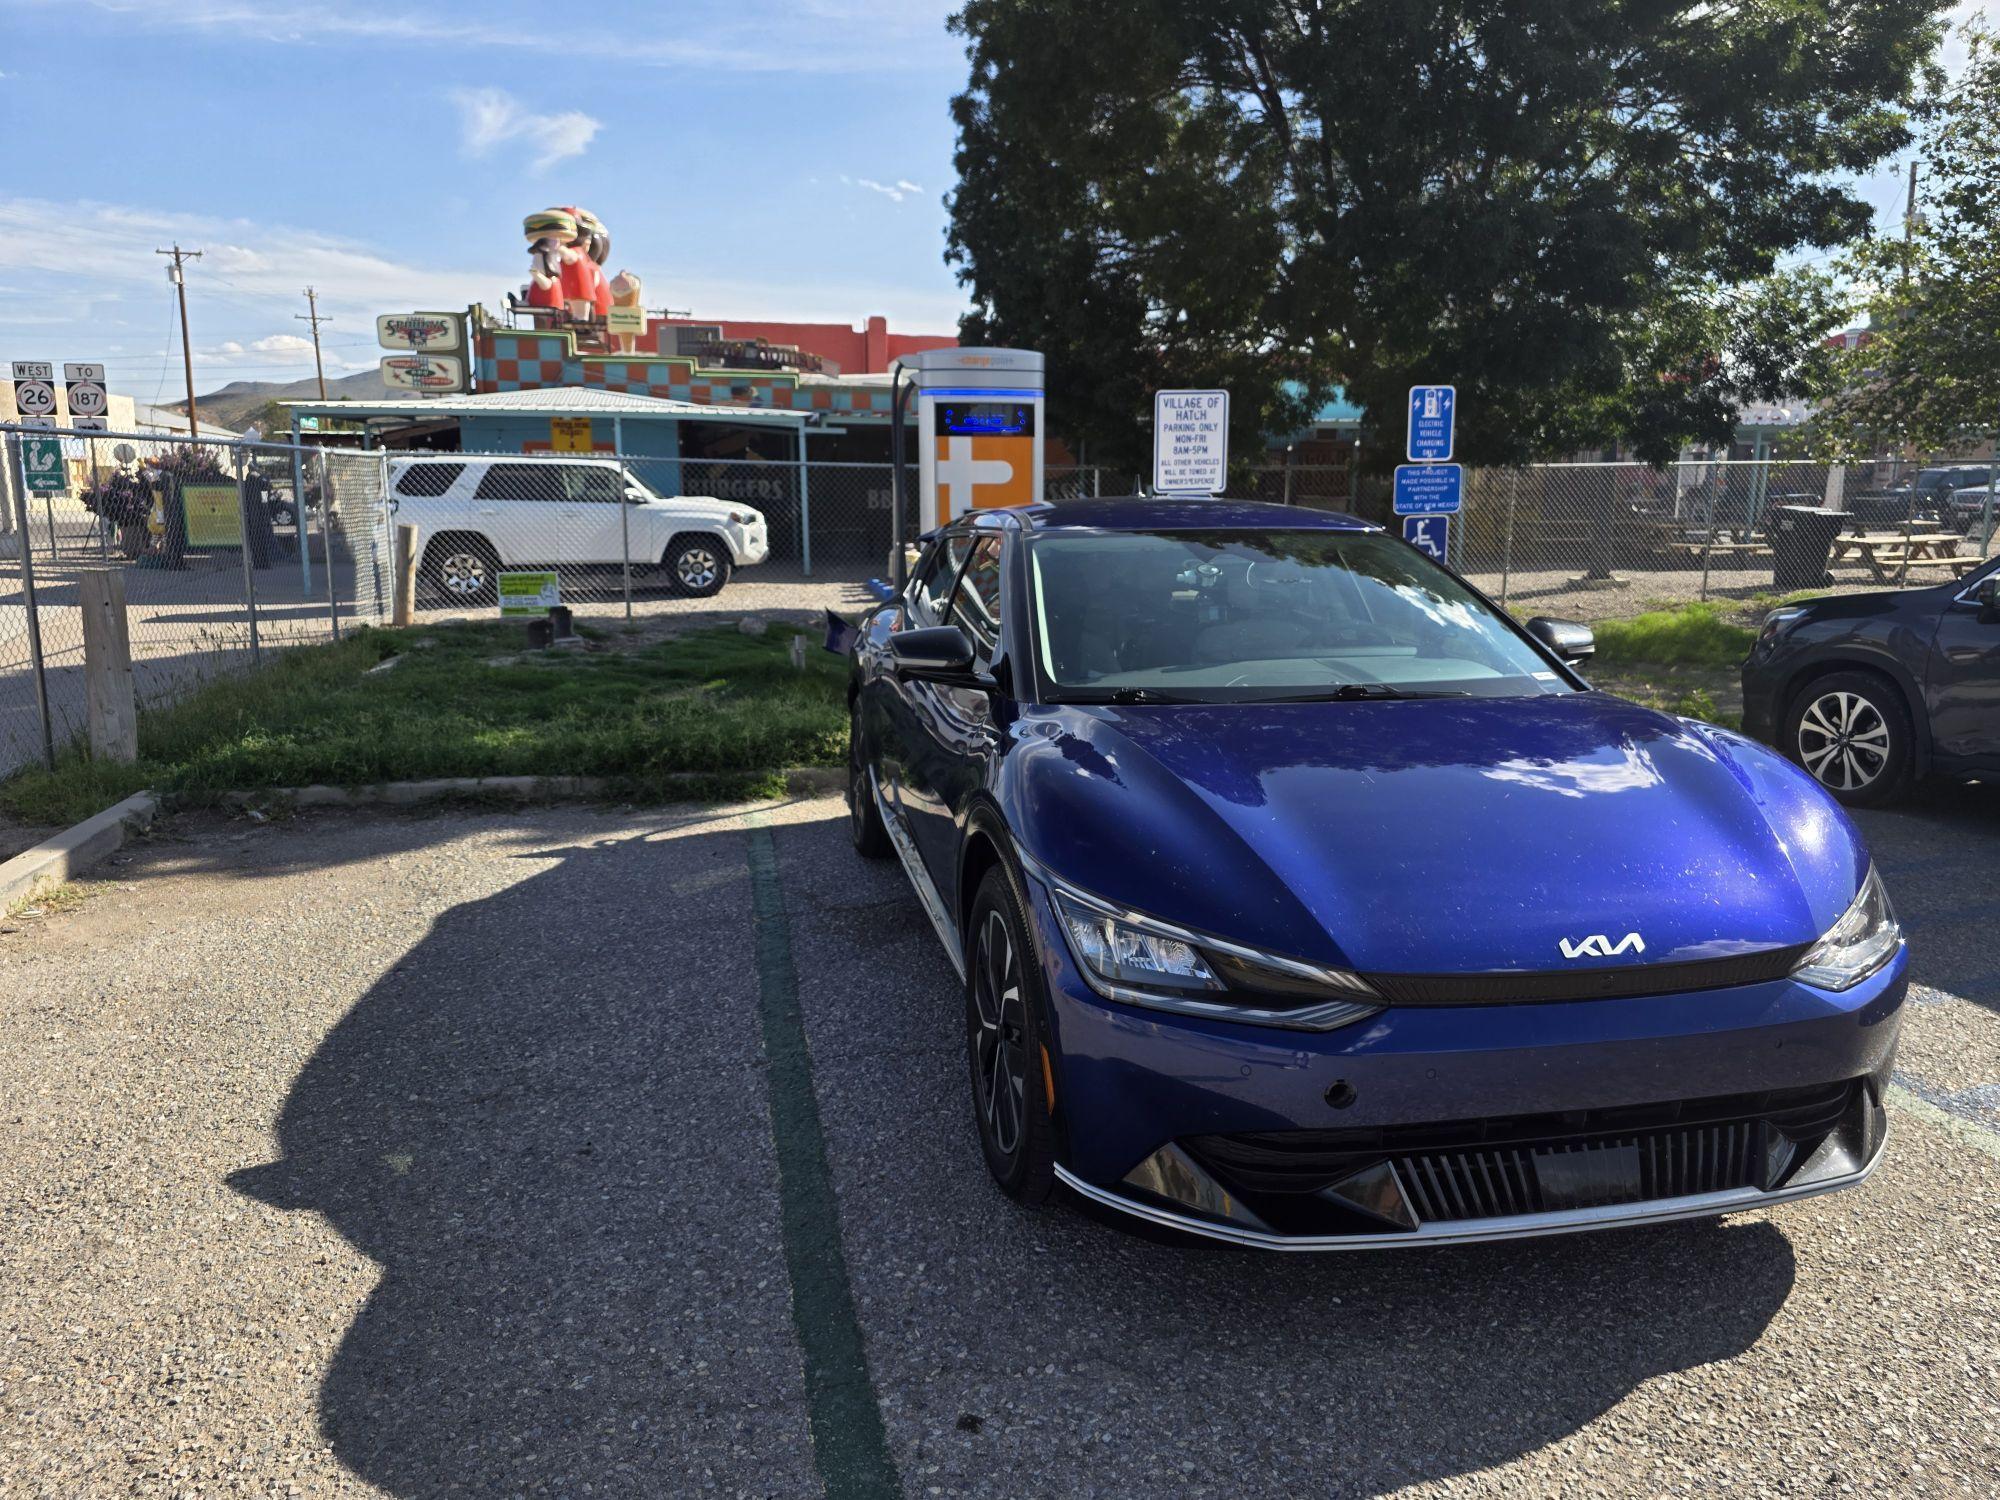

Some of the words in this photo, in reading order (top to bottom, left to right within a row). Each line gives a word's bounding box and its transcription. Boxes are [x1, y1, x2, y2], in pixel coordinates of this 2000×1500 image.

[16, 364, 48, 376] WEST
[76, 367, 93, 377] TO
[23, 389, 49, 405] 26
[75, 392, 99, 405] 187
[1163, 397, 1203, 409] VILLAGE
[1207, 396, 1220, 408] OF
[1176, 410, 1207, 421] HATCH
[1163, 423, 1195, 432] PARKING
[1199, 423, 1218, 432] ONLY
[1418, 420, 1444, 428] ELECTRIC
[1420, 429, 1442, 437] VEHICLE
[1175, 434, 1207, 443] MON-FRI
[1416, 439, 1445, 447] CHARGING
[1173, 446, 1208, 455] 8AM-5PM
[1422, 449, 1437, 457] ONLY
[1194, 458, 1219, 466] VEHICLES
[1559, 932, 1646, 958] KIA
